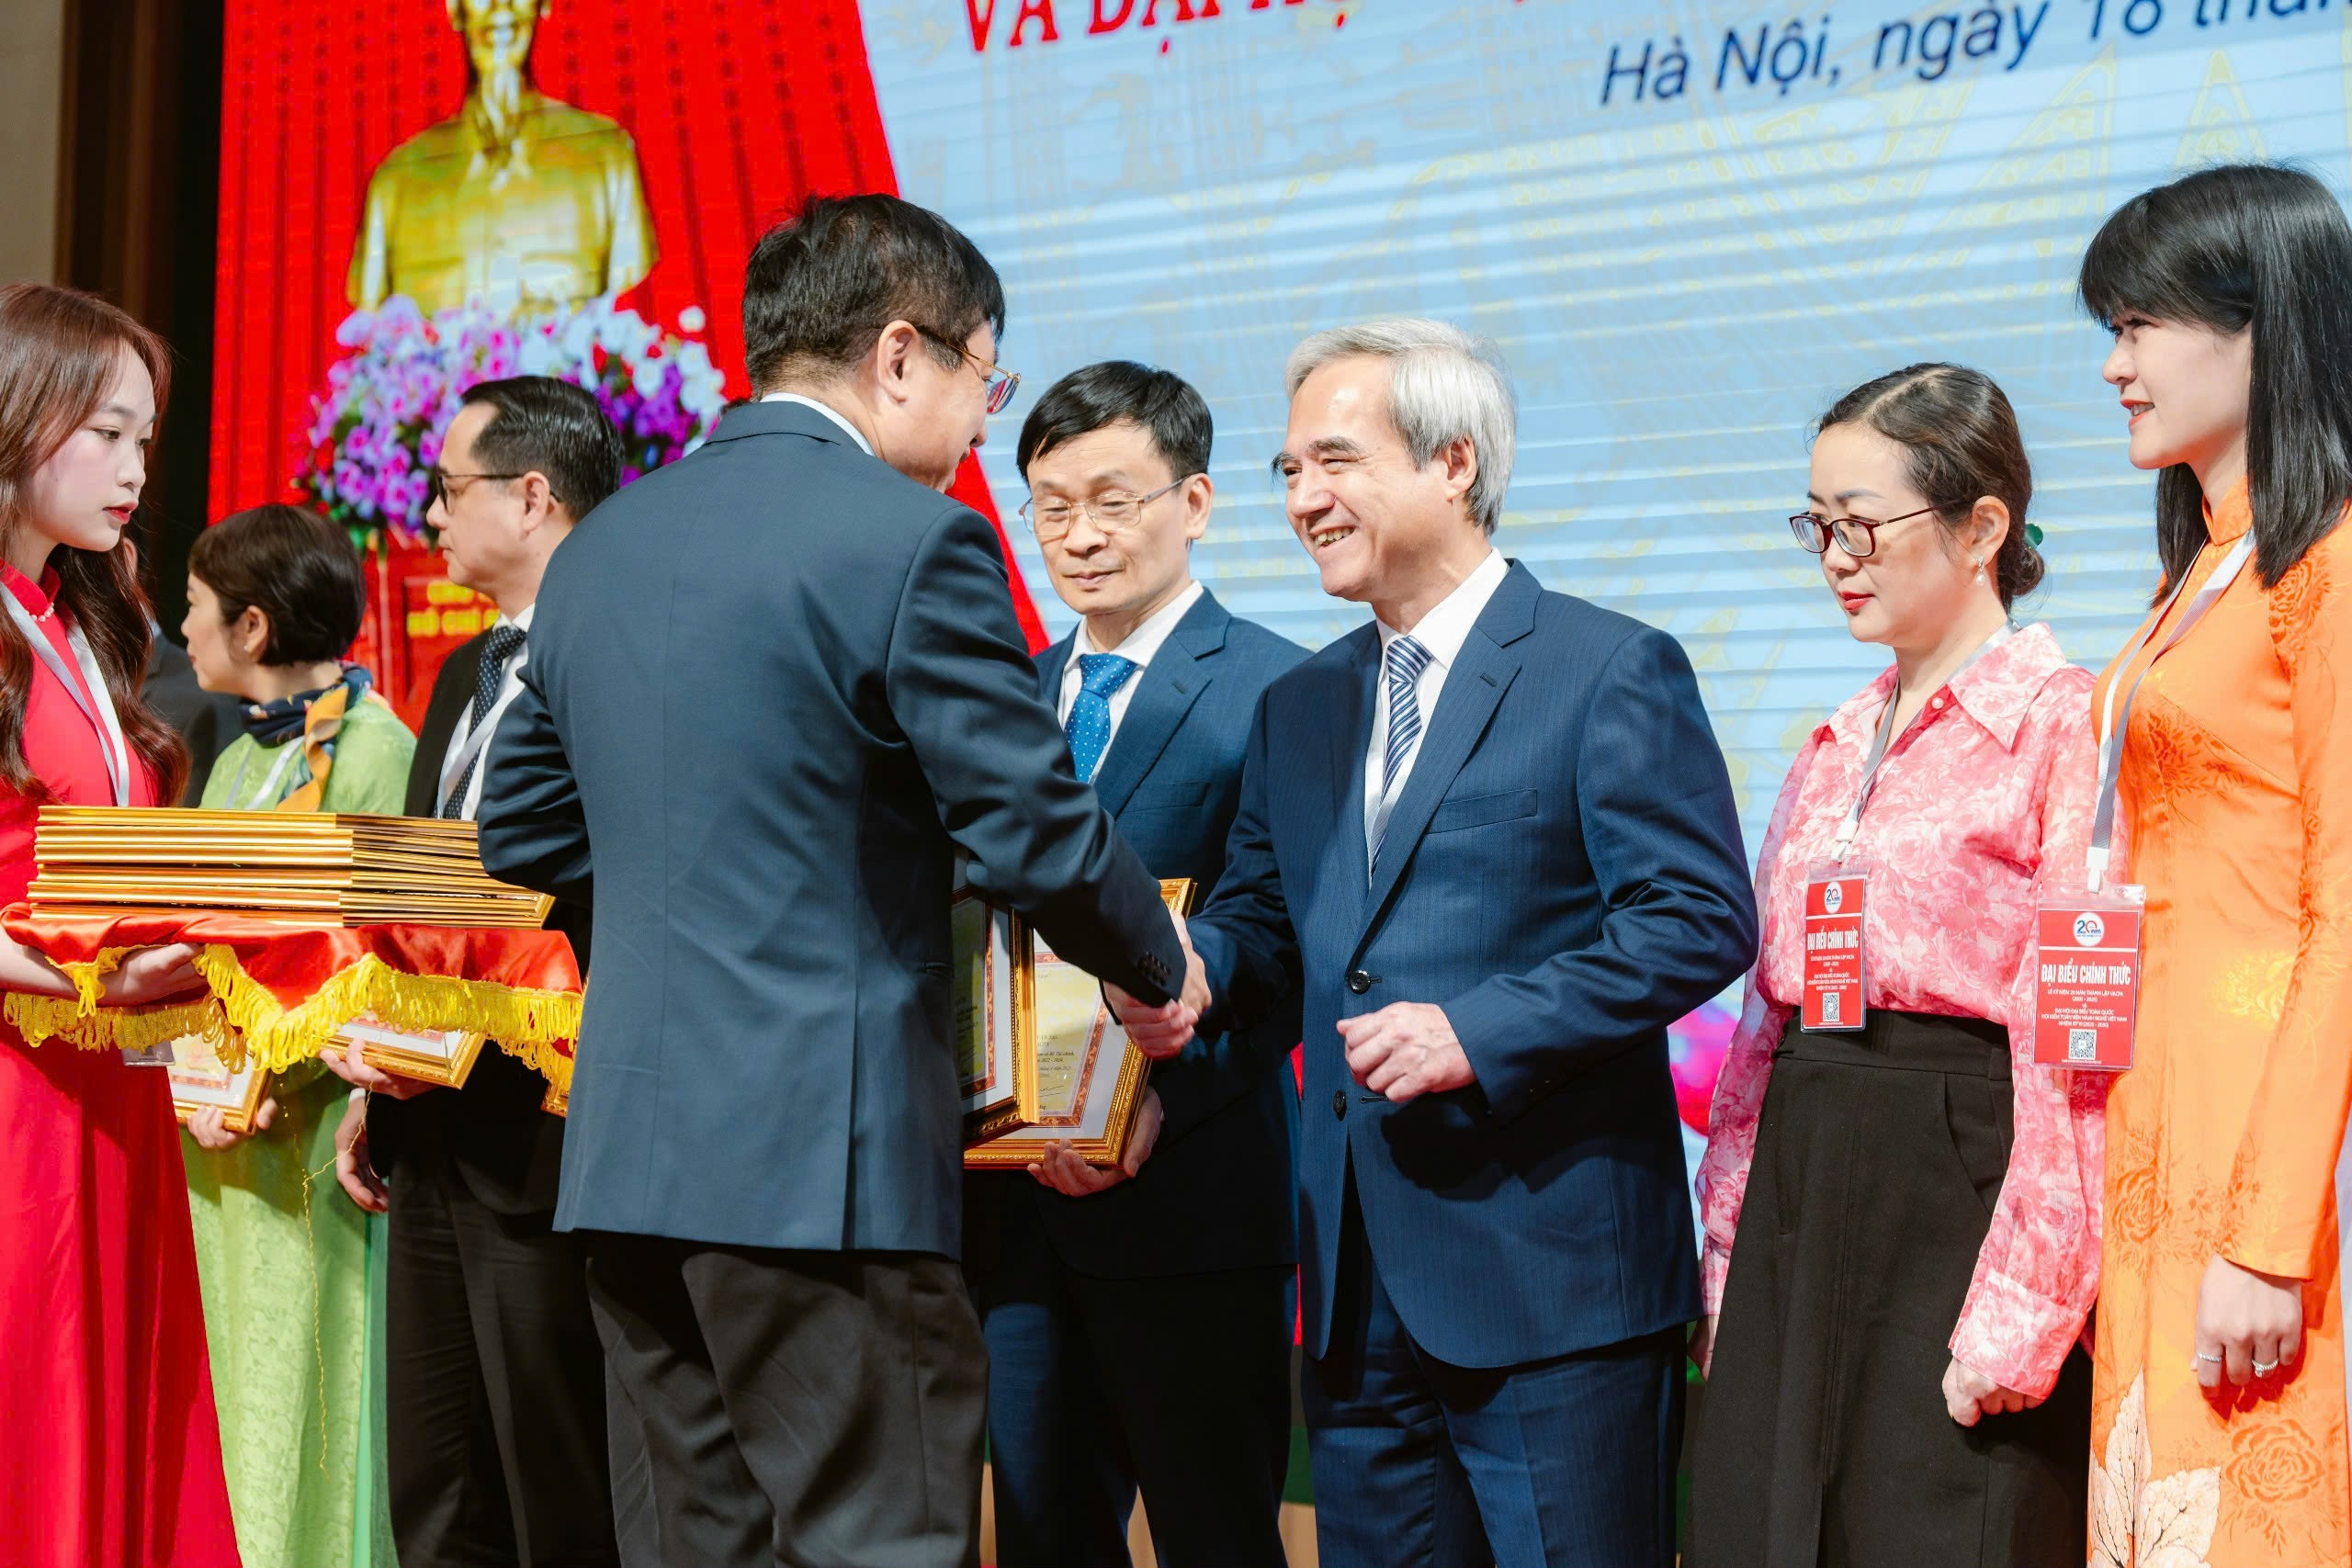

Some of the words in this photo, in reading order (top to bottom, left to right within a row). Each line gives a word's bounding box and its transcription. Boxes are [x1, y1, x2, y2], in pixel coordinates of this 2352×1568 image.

[1600, 35, 1690, 106] Hà
[1715, 15, 1839, 97] Nội,
[2041, 964, 2057, 987] ĐẠI
[2058, 957, 2078, 984] BIỂU
[2079, 961, 2107, 985] CHÍNH
[2109, 960, 2131, 985] THỨC
